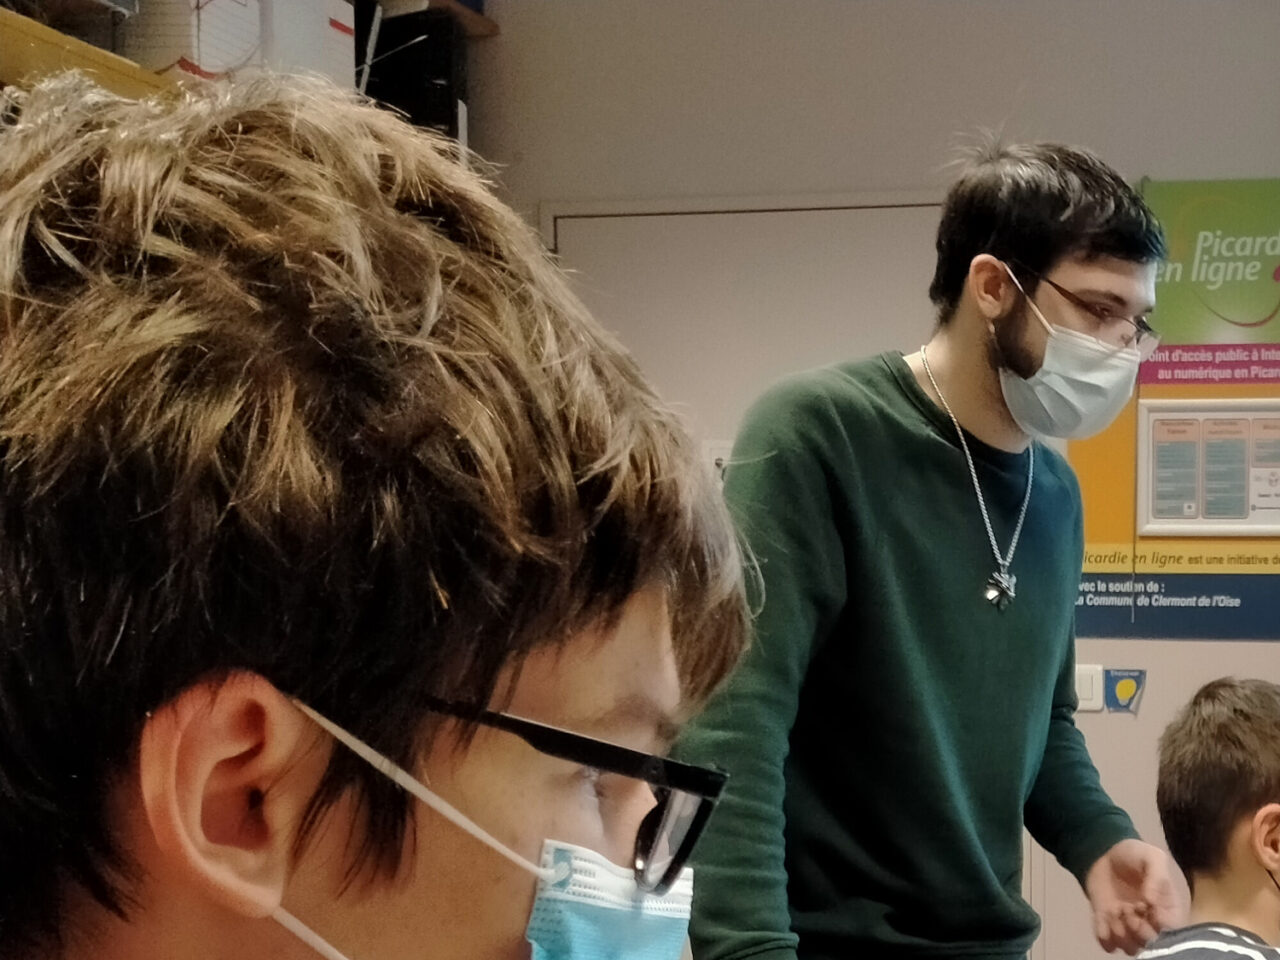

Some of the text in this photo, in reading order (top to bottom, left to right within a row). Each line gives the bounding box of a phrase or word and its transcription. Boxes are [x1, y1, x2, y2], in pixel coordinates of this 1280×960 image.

[1192, 255, 1262, 290] ligne
[1148, 350, 1170, 363] oint
[1215, 348, 1249, 363] public
[1158, 368, 1172, 379] au
[1174, 366, 1232, 381] numérique
[1234, 368, 1248, 378] en
[1083, 551, 1128, 564] icardie
[1151, 551, 1183, 568] ligne
[1188, 555, 1202, 565] est
[1206, 556, 1224, 565] une
[1227, 554, 1268, 565] initiative
[1078, 582, 1095, 593] vec
[1098, 581, 1106, 593] le
[1146, 581, 1158, 593] de
[1136, 595, 1149, 606] de
[1151, 595, 1196, 607] Clermont
[1198, 595, 1210, 607] de
